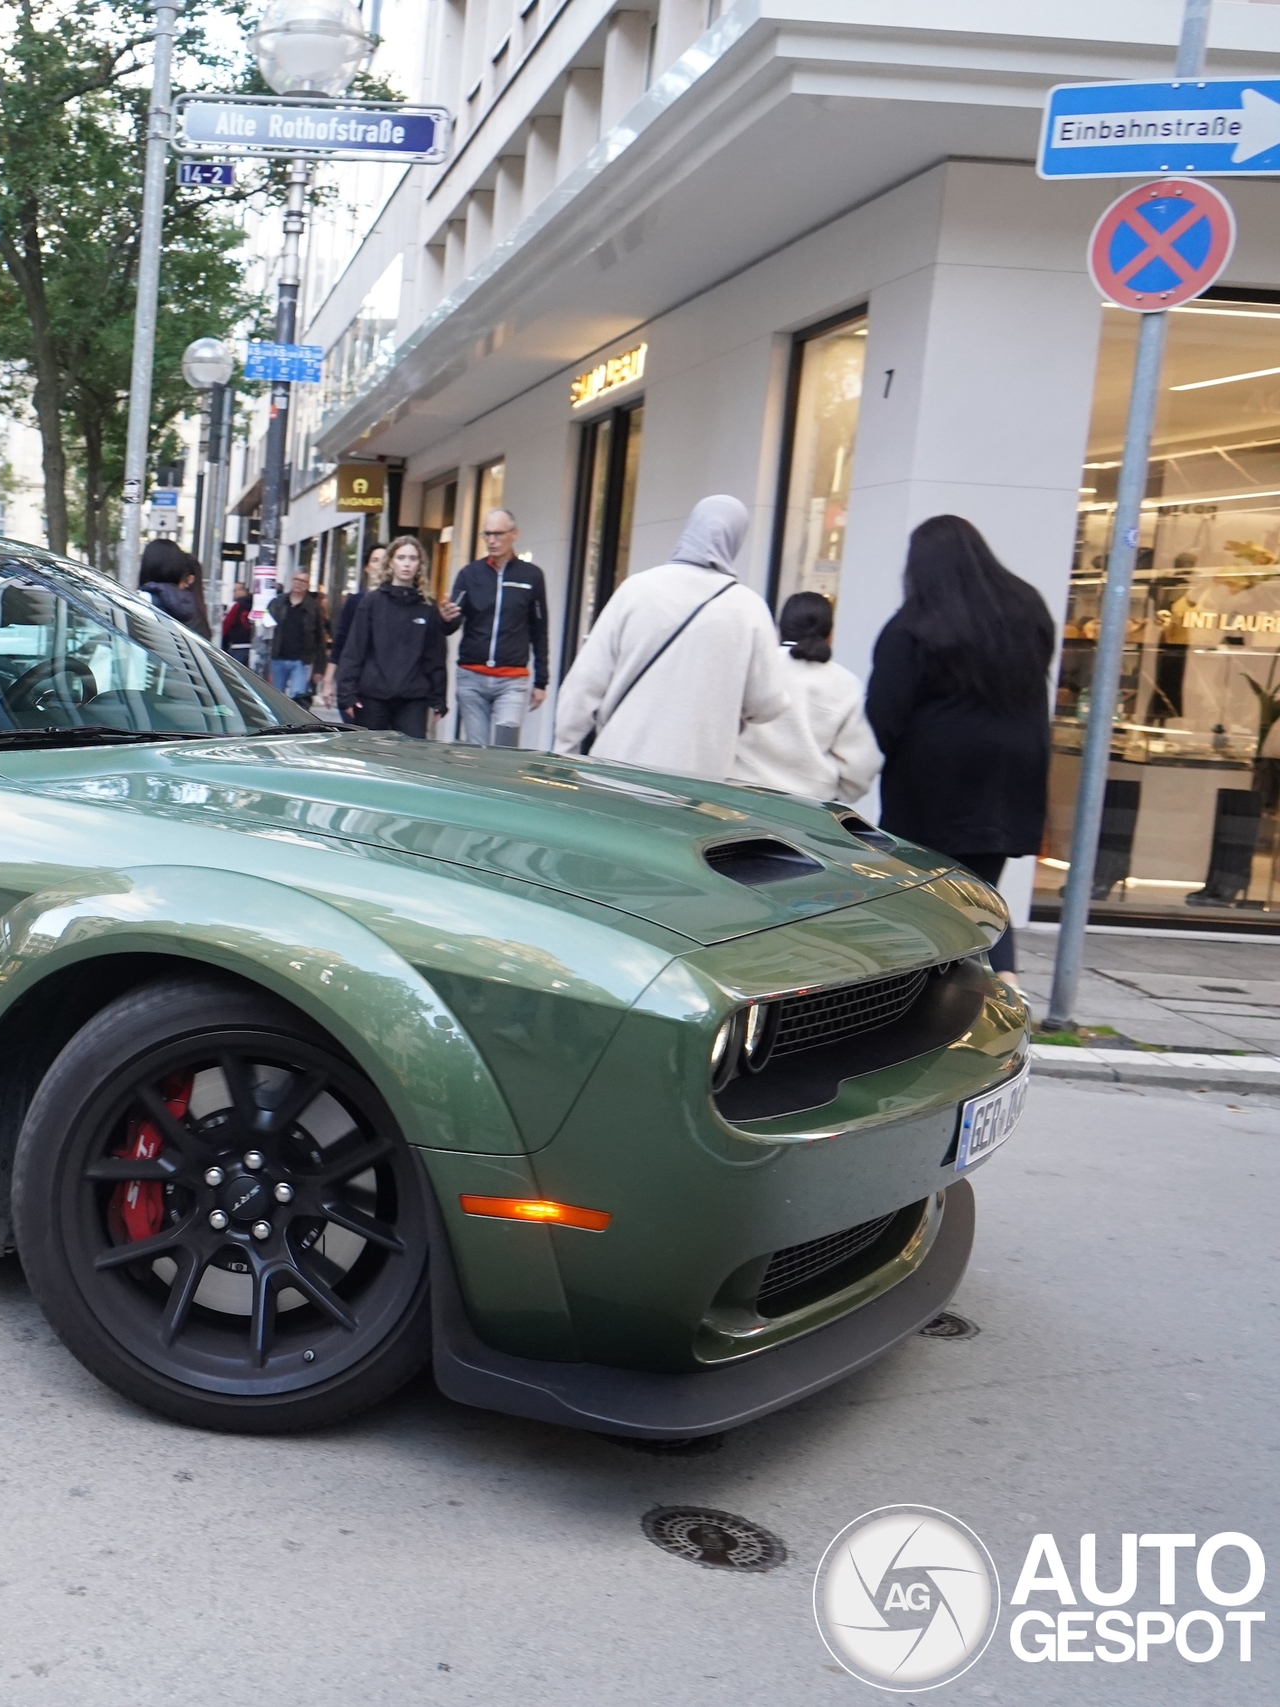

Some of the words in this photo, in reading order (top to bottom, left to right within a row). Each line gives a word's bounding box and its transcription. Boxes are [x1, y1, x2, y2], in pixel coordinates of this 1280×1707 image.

[214, 111, 257, 137] Alte
[268, 113, 406, 144] Rothofstraße
[1059, 116, 1243, 141] Einbahnstraße
[183, 164, 224, 184] 14-2
[1155, 609, 1218, 629] SINT
[969, 1096, 1003, 1155] GER
